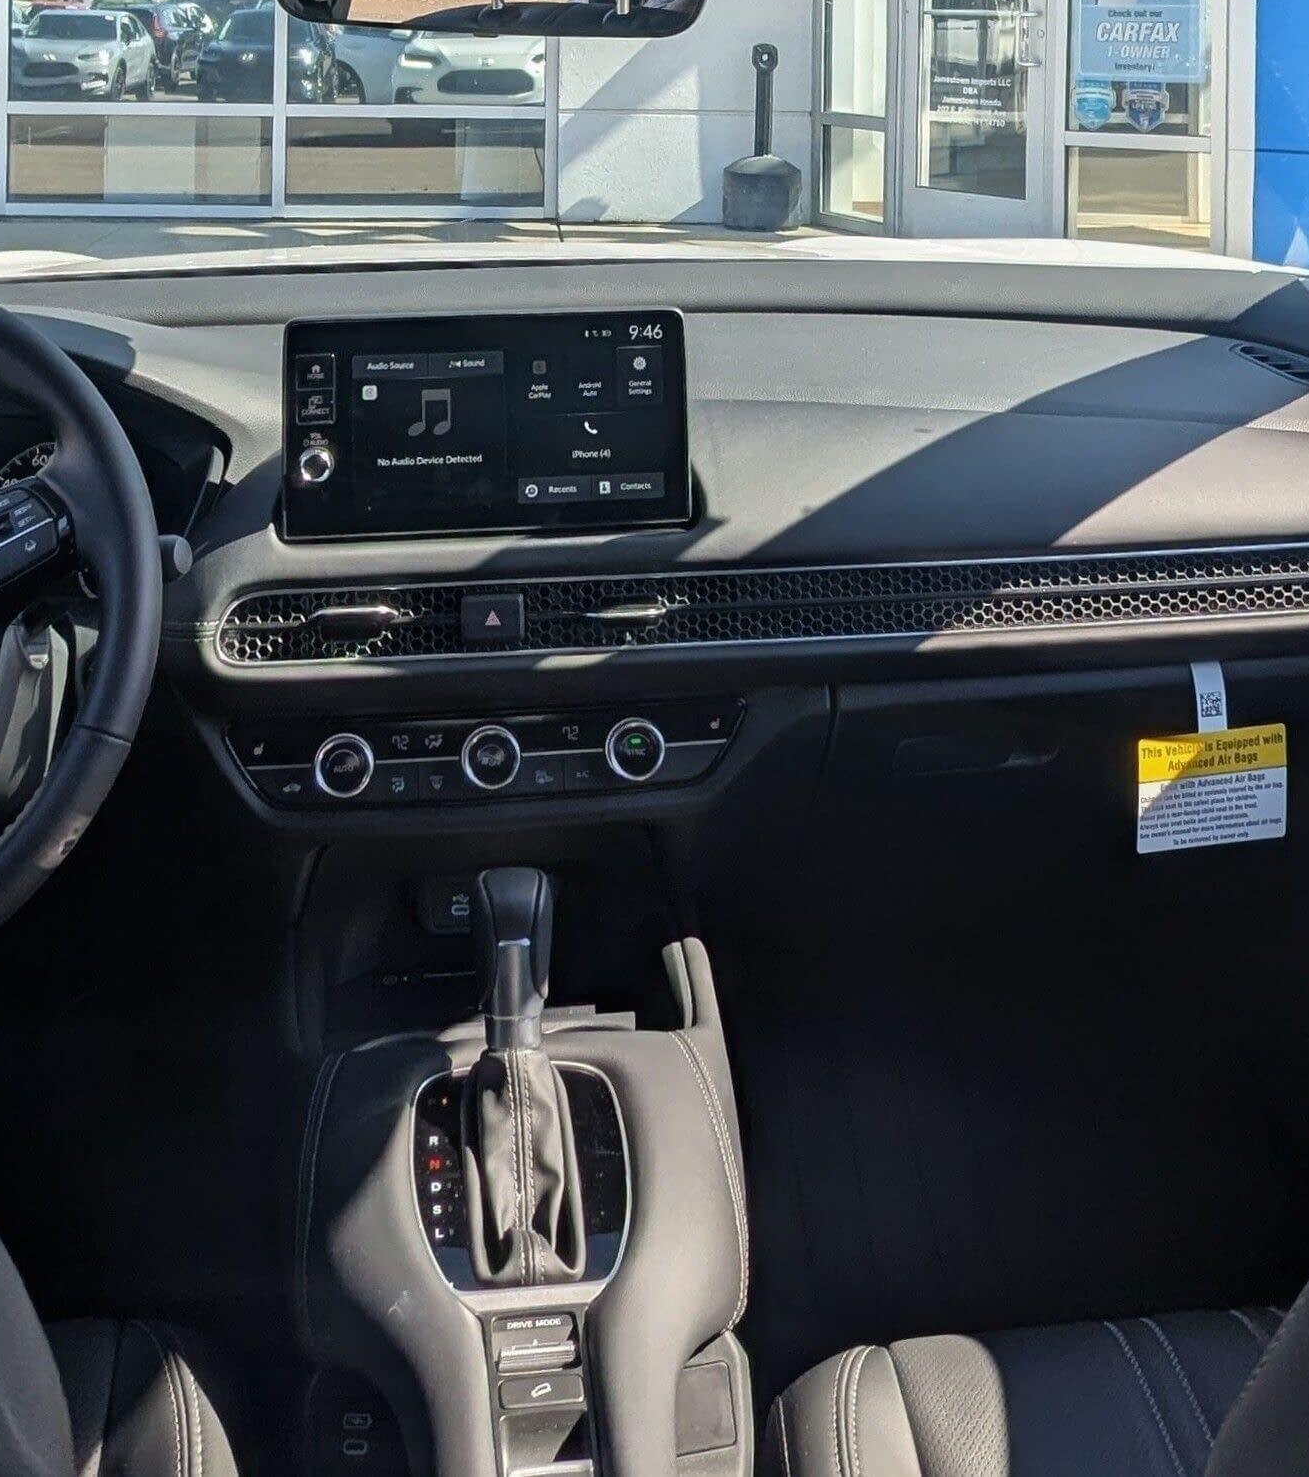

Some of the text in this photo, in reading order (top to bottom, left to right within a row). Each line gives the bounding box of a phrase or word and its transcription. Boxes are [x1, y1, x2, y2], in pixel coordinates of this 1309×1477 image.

[1096, 22, 1180, 42] CARFAX
[1106, 45, 1171, 59] 1-OWNER
[997, 77, 1012, 87] LLC
[628, 324, 663, 340] 9:46
[367, 361, 415, 371] Audio Source
[463, 359, 485, 368] Sound
[578, 381, 602, 389] Android
[628, 379, 652, 387] General
[583, 389, 598, 397] Auto
[628, 387, 652, 396] Settings
[572, 449, 611, 459] iPhone (4)
[32, 454, 49, 466] 60
[377, 454, 483, 467] No Audio Device Detected
[548, 485, 578, 494] Recents
[620, 482, 652, 491] Contacts
[1141, 747, 1162, 759] This
[1216, 735, 1260, 751] Equipped
[1262, 732, 1283, 744] with
[1167, 752, 1258, 772] Advanced Air Bags
[1197, 775, 1233, 788] Advanced
[1235, 774, 1246, 783] Air
[429, 1136, 439, 1146] R
[429, 1159, 440, 1169] N
[431, 1182, 441, 1192] D
[432, 1205, 442, 1215] S
[435, 1228, 445, 1238] L
[506, 1318, 562, 1330] DRIVE MODE
